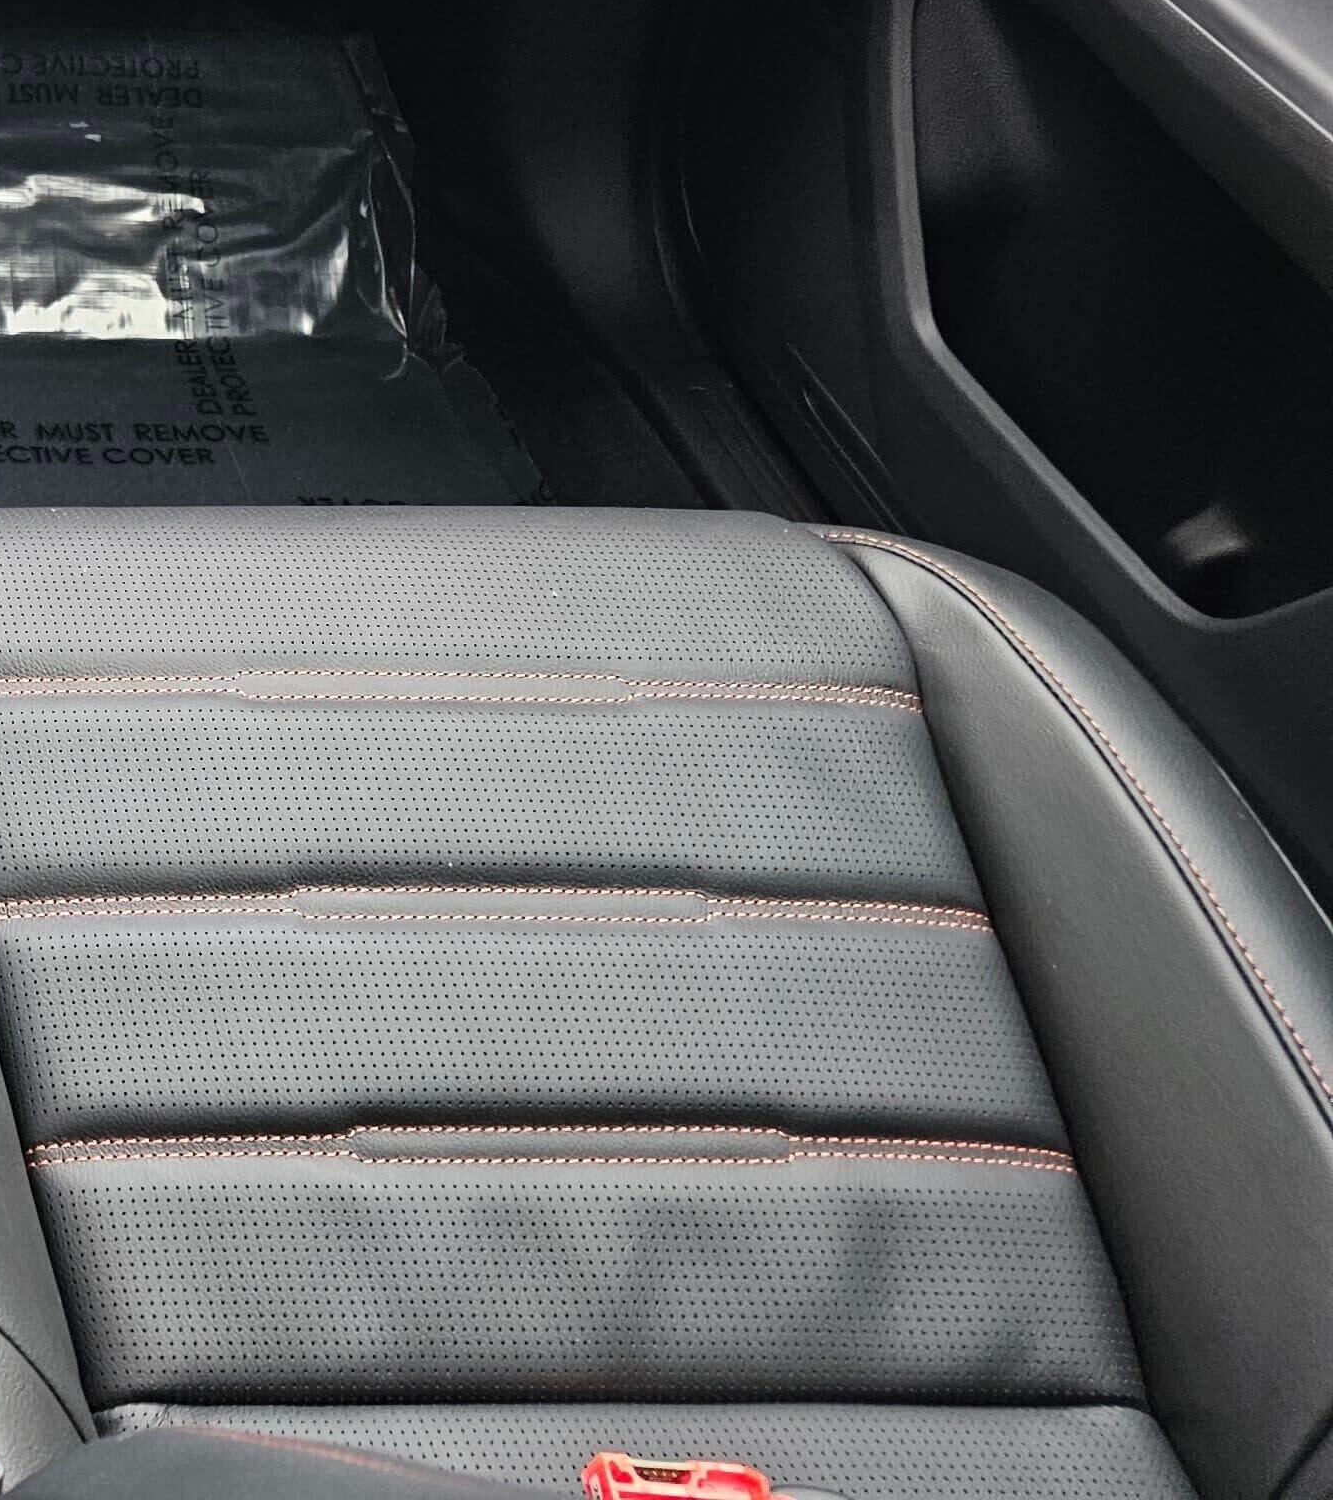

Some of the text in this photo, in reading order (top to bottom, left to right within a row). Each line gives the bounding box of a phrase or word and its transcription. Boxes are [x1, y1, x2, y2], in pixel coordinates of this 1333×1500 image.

[34, 51, 200, 80] PROTECTIVE
[6, 82, 79, 106] MUST
[98, 85, 204, 108] DEALER
[174, 339, 223, 416] DEALER
[34, 421, 116, 443] MUST
[133, 421, 271, 446] REMOVE
[100, 445, 217, 467] COVER
